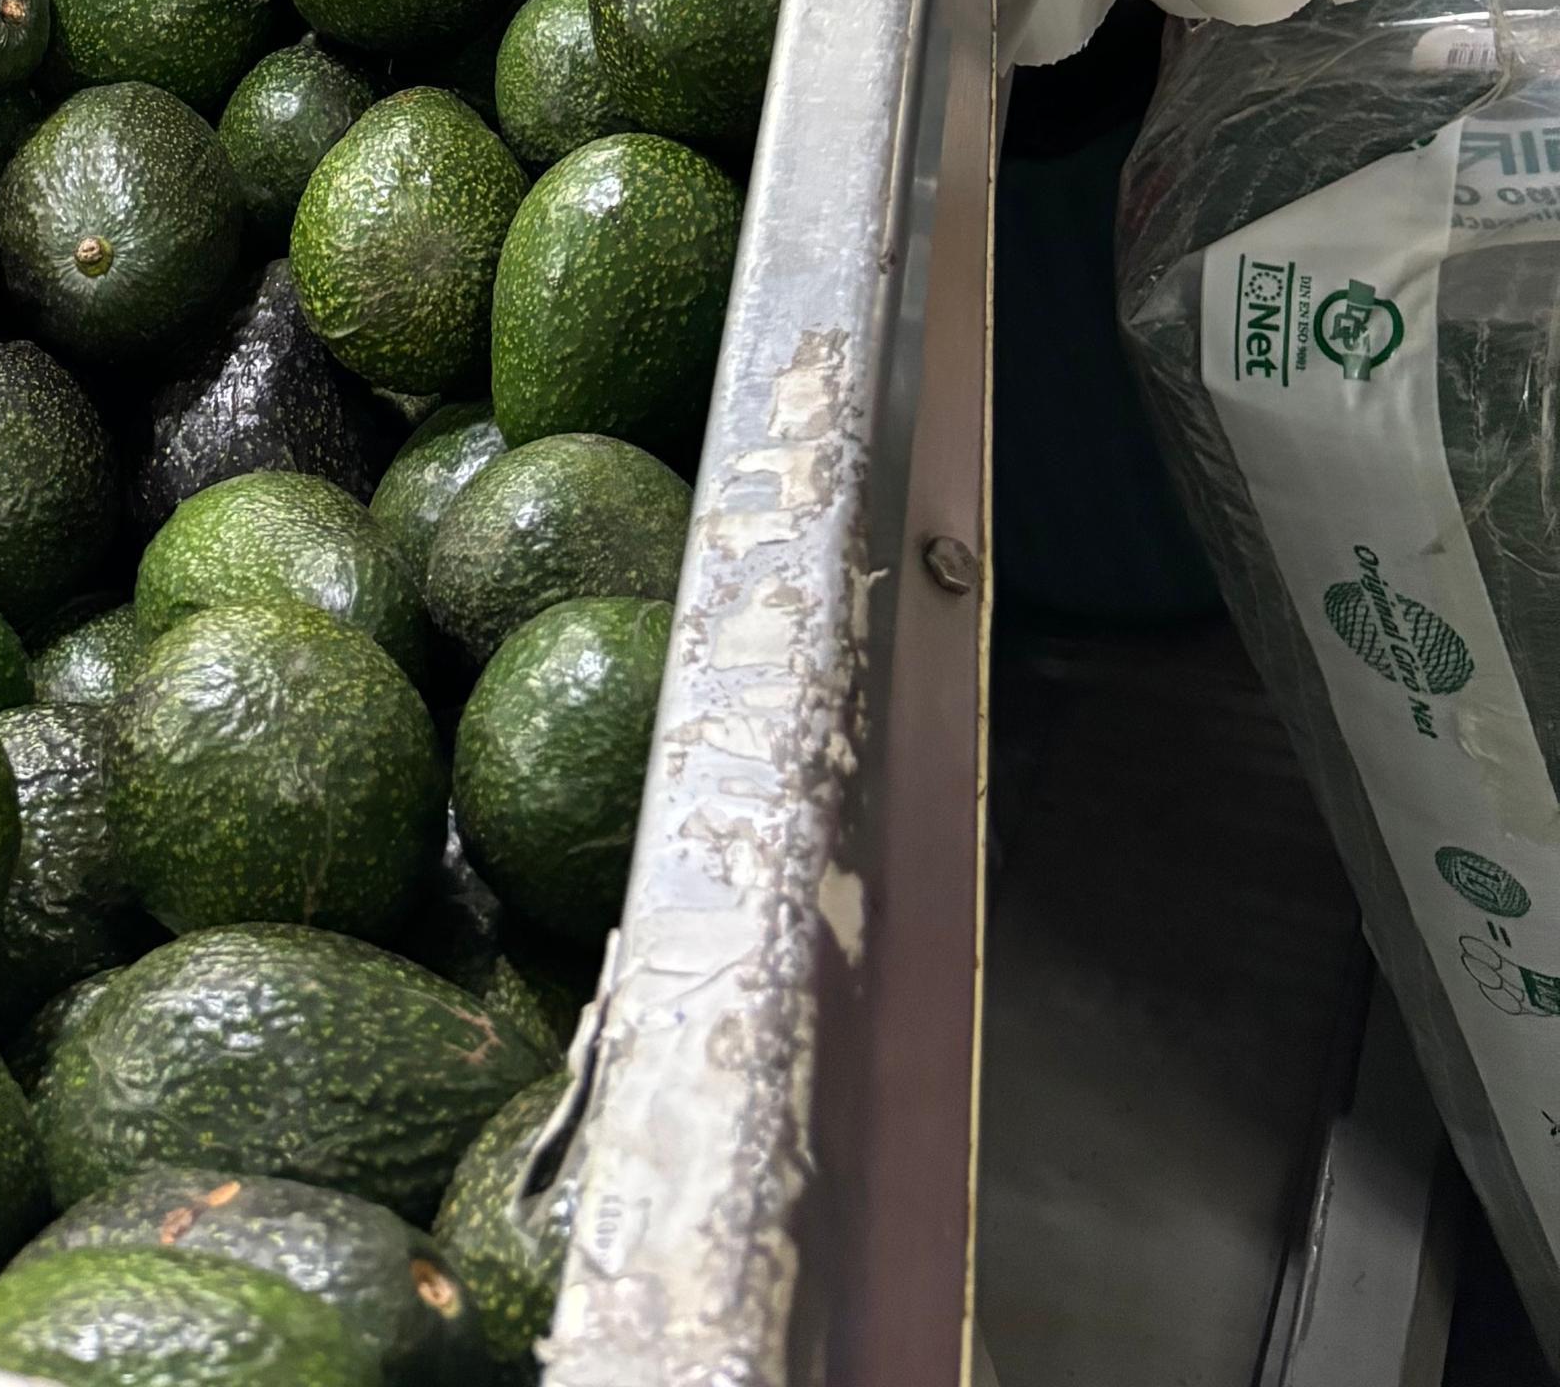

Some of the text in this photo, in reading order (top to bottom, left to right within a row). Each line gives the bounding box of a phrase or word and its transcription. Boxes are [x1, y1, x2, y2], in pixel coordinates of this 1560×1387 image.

[1353, 543, 1438, 740] Original Giro Net
